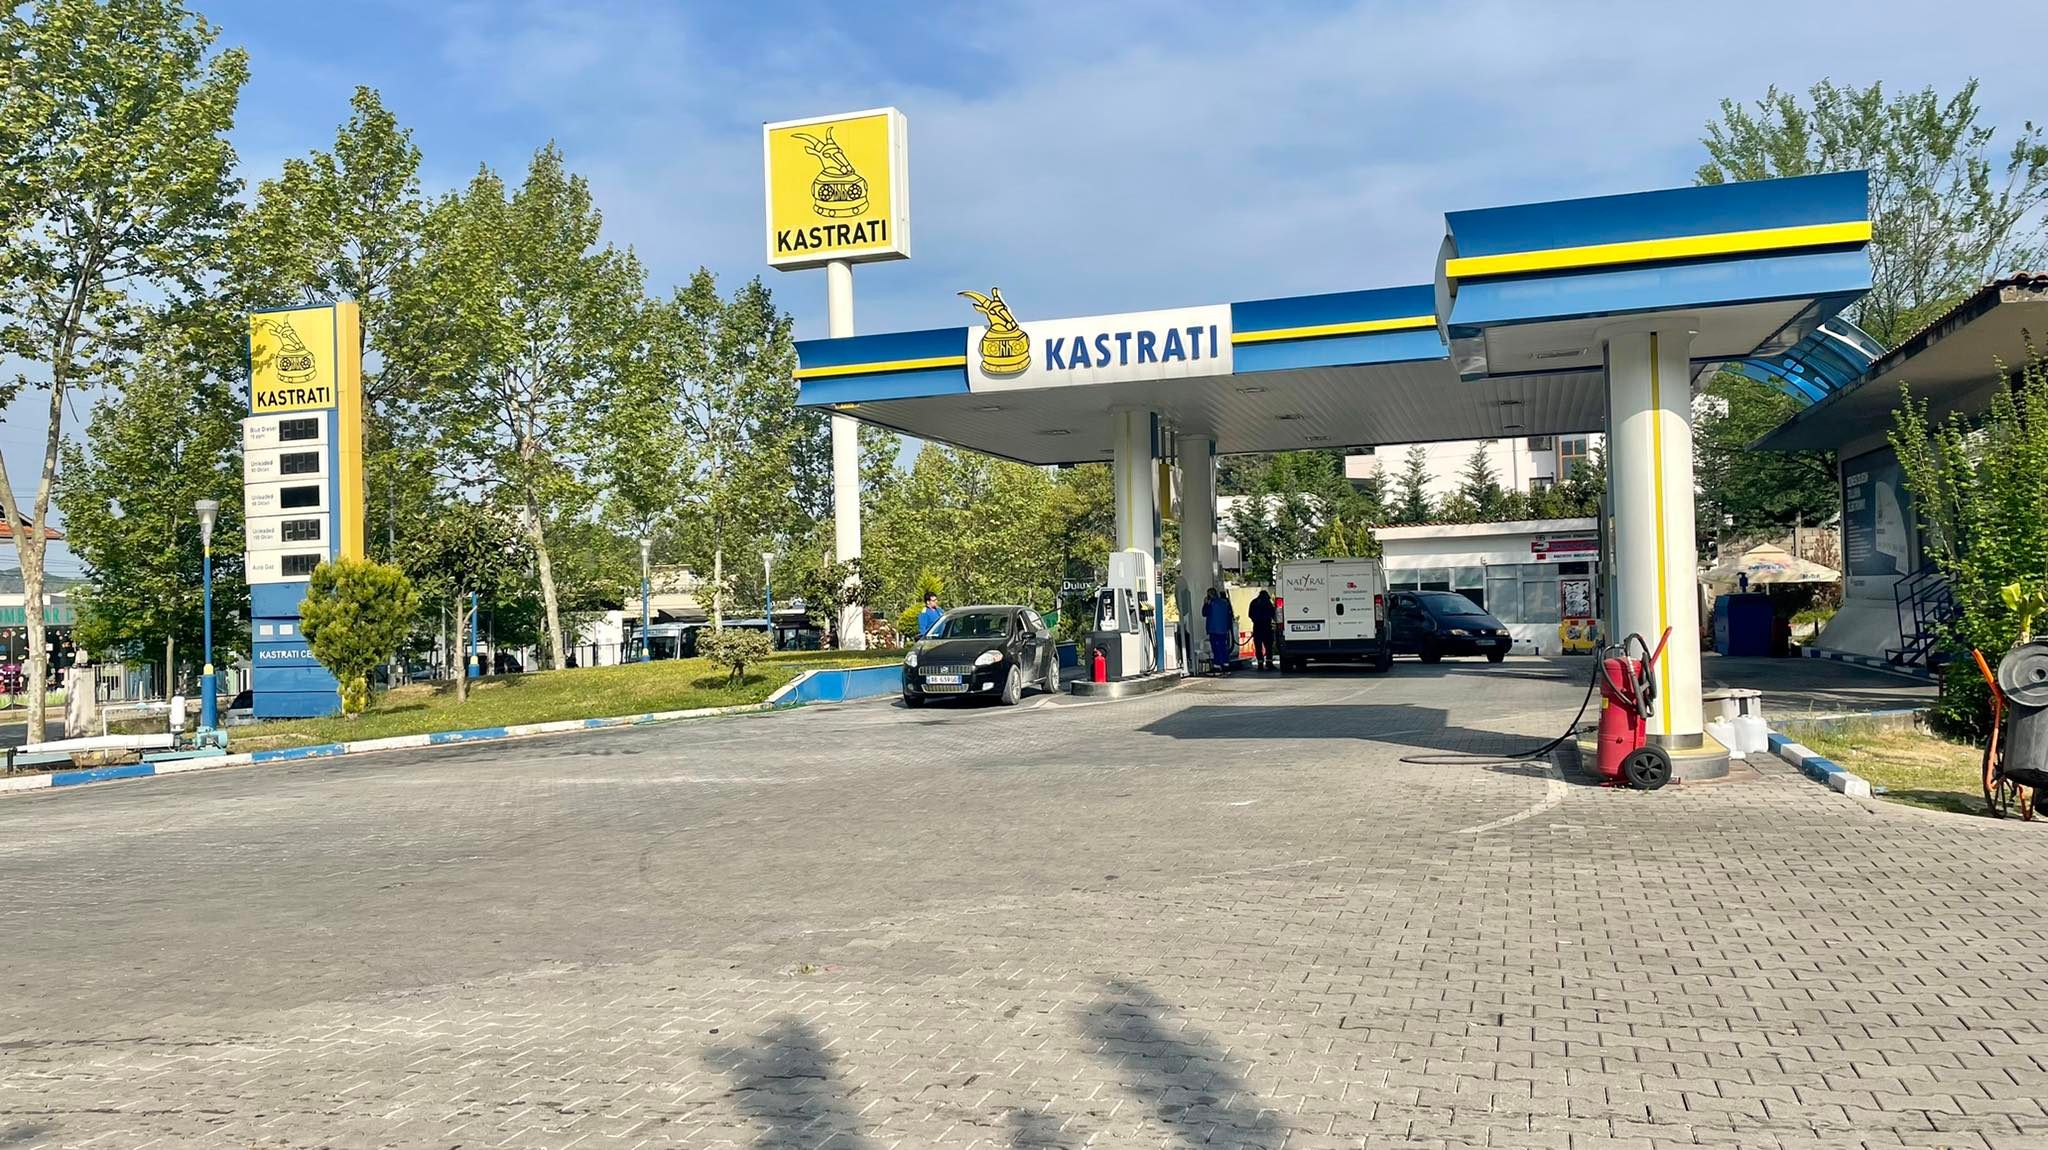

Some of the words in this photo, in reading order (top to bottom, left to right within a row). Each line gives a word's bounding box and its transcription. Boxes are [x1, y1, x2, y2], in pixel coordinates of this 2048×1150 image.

[777, 219, 887, 252] KASTRATI
[1045, 325, 1218, 371] KASTRATI
[257, 386, 330, 408] KASTRATI
[1063, 581, 1091, 590] Dulux
[259, 650, 299, 659] KASTRATI
